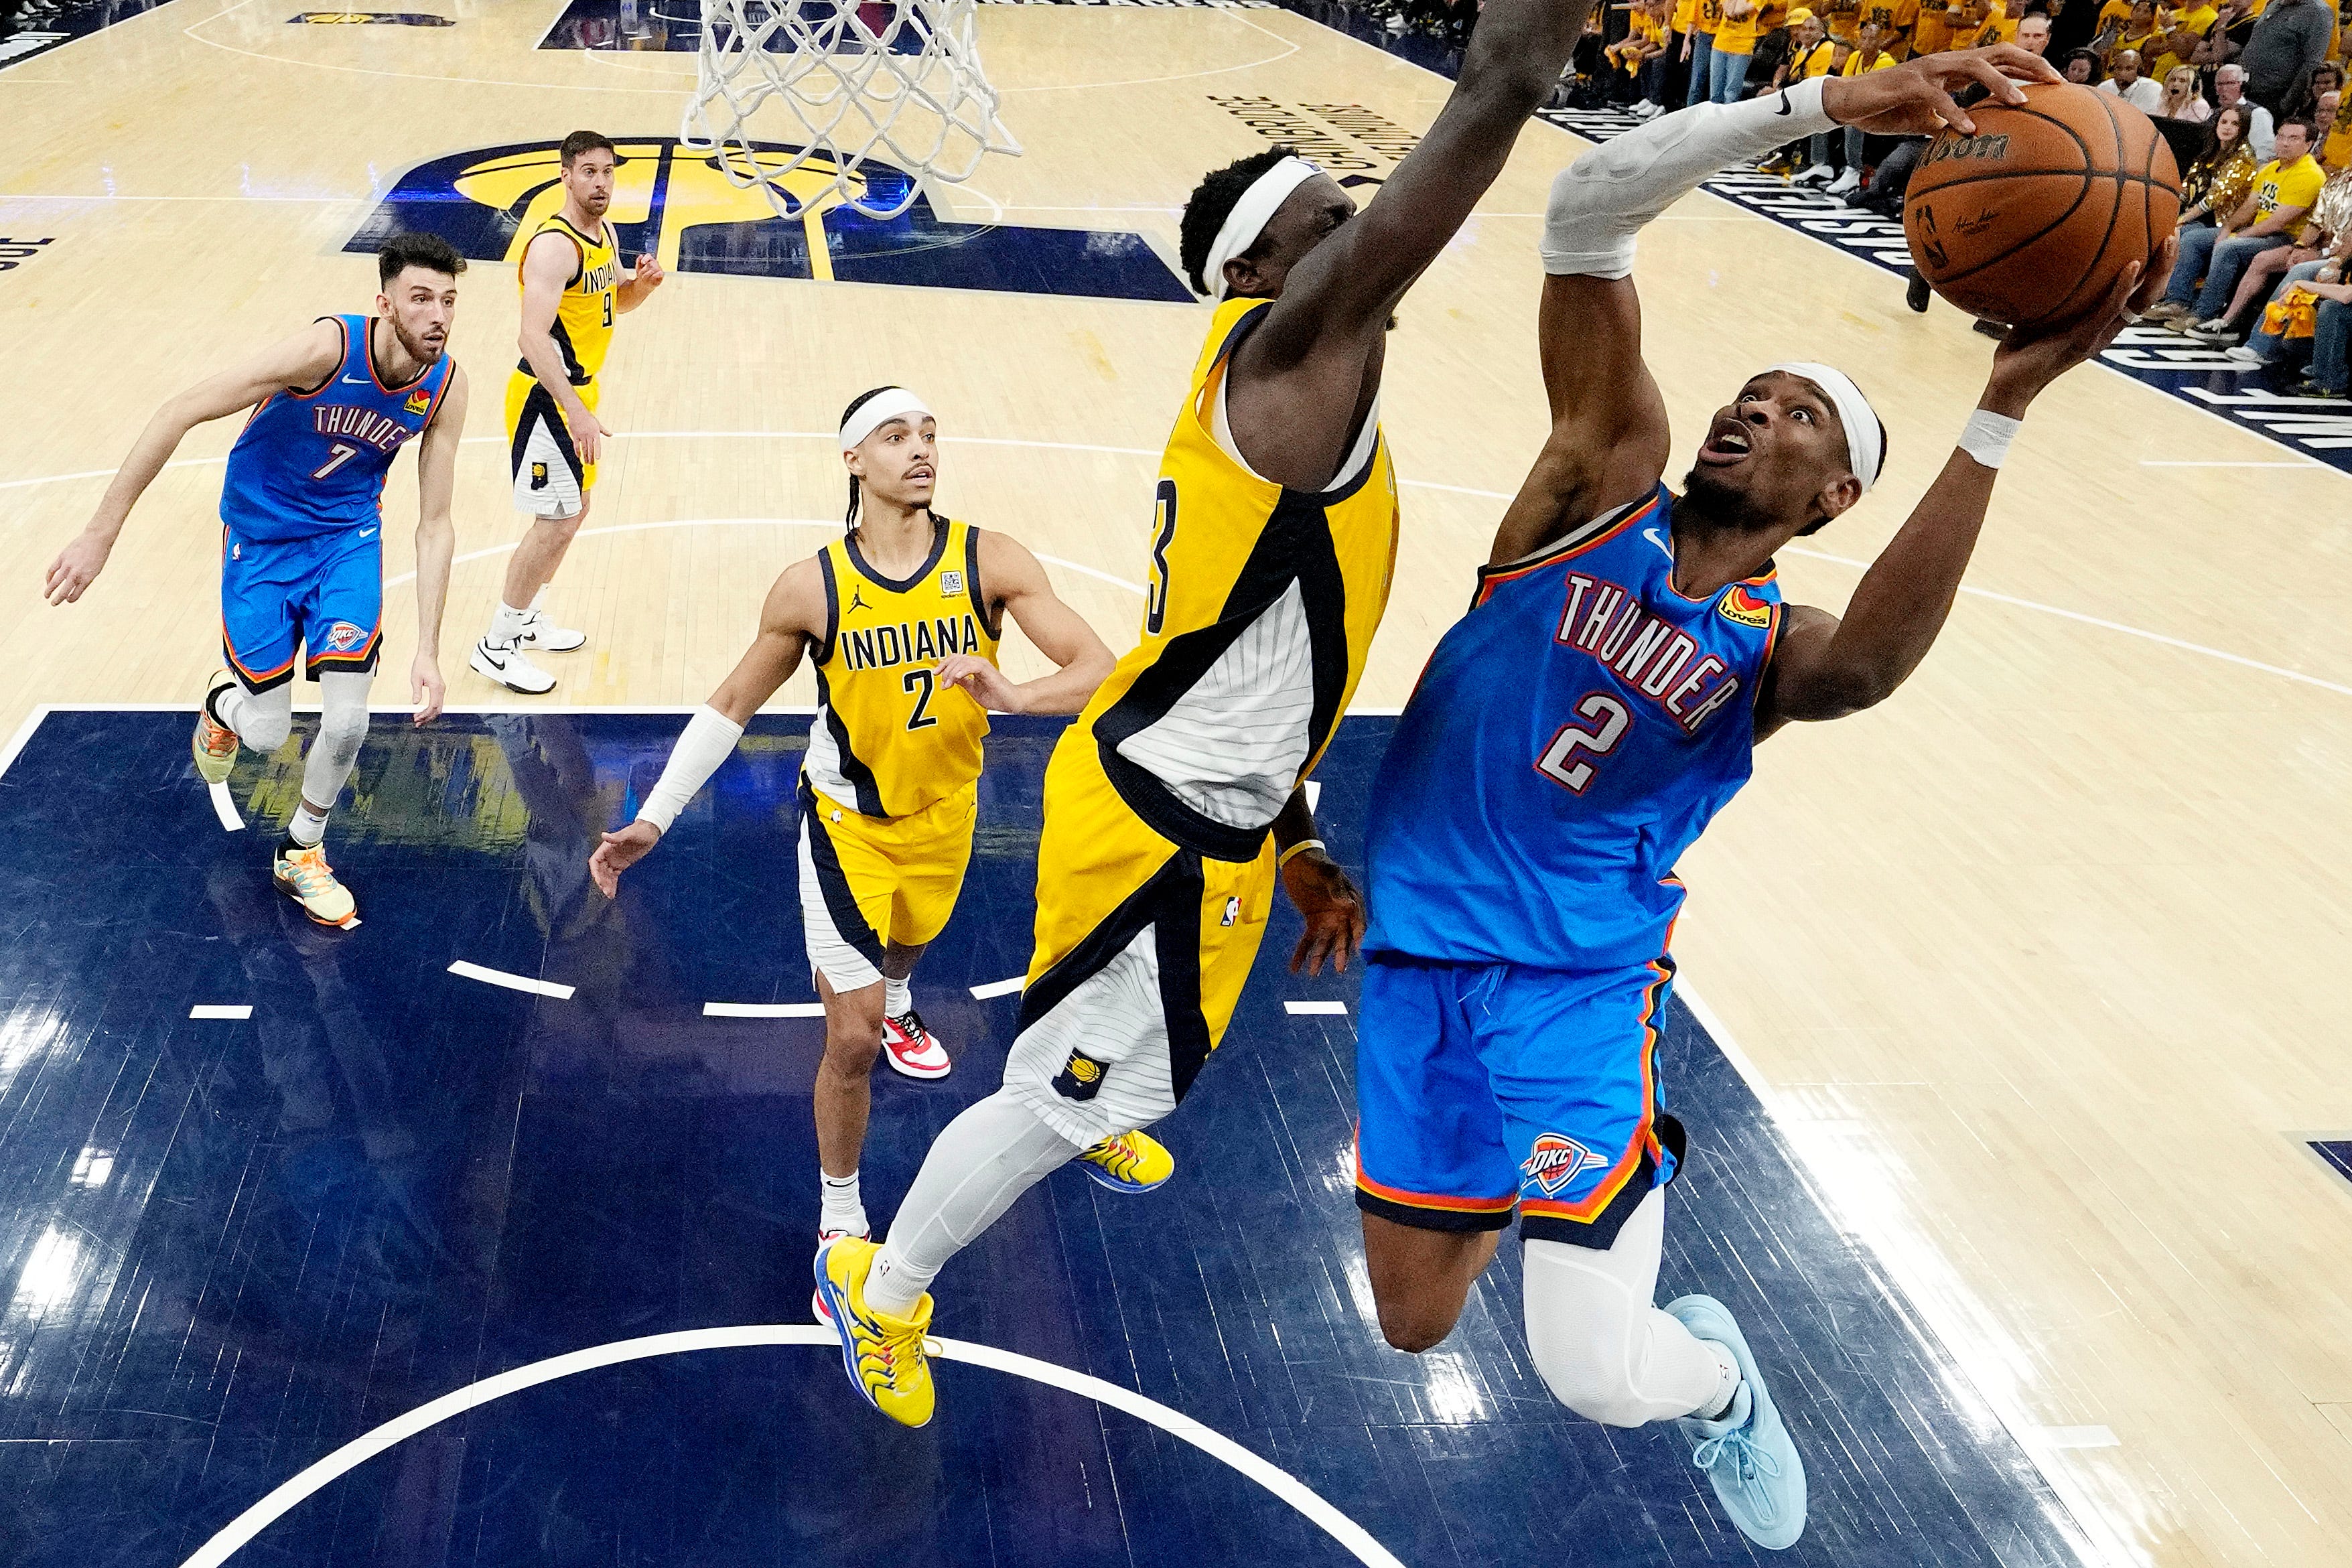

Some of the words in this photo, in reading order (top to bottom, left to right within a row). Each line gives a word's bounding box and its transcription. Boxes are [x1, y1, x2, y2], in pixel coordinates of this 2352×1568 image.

[1206, 95, 1377, 169] GAINBRIDGE
[1297, 102, 1422, 161] ELDHOUSE
[583, 261, 616, 294] INDIA
[602, 291, 613, 328] 9
[313, 405, 413, 451] THUNDE
[312, 442, 358, 480] 7
[1720, 600, 1767, 624] Love's
[328, 629, 355, 642] OKC
[840, 614, 980, 672] INDIANA
[1558, 573, 1740, 734] THUNDER
[902, 668, 938, 732] 2
[1535, 691, 1633, 795] 2
[1527, 1148, 1572, 1178] OKC
